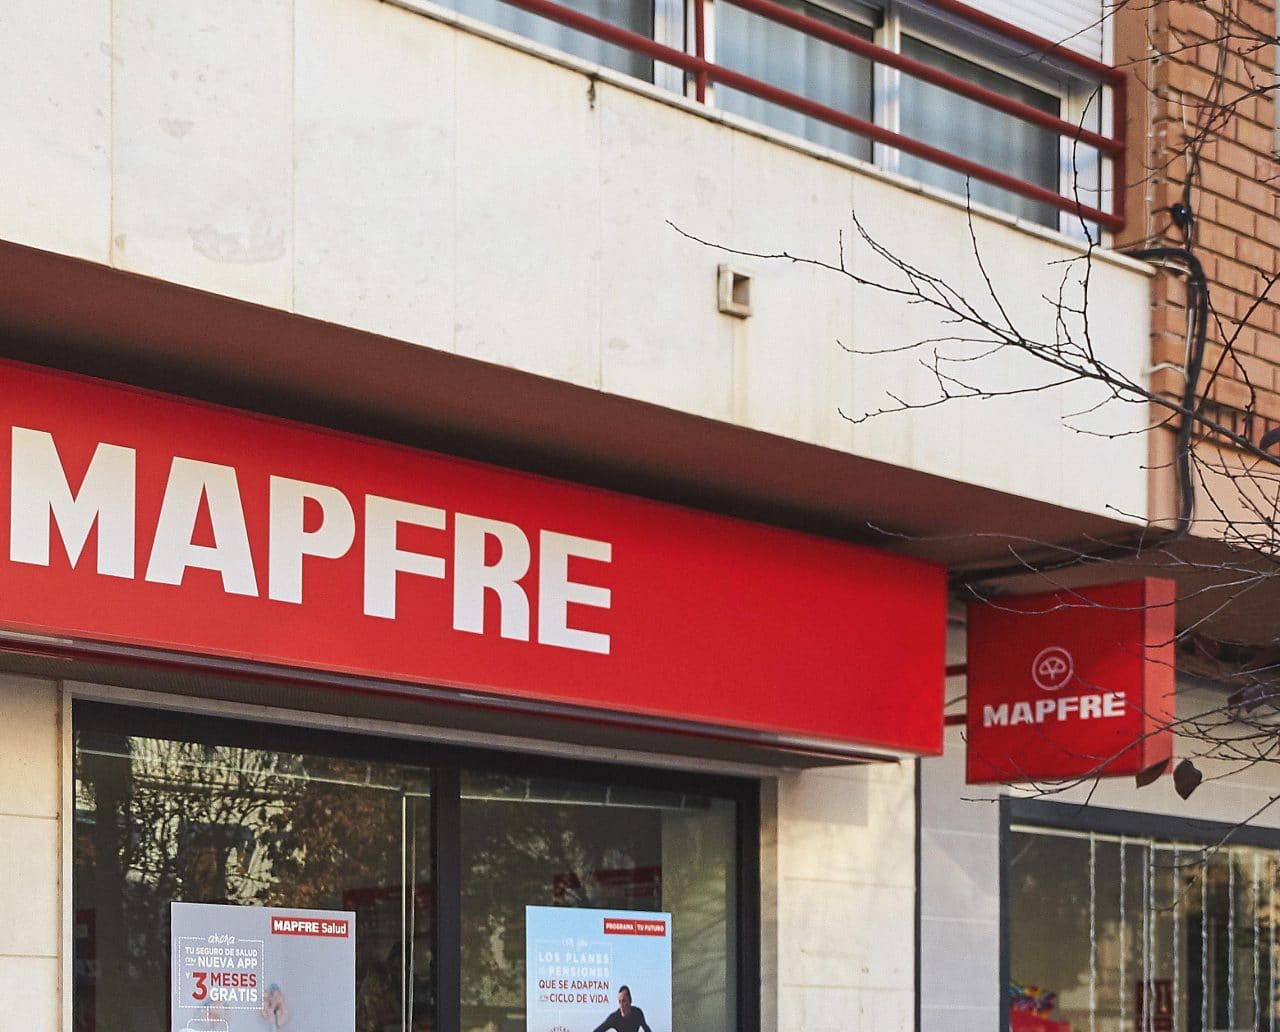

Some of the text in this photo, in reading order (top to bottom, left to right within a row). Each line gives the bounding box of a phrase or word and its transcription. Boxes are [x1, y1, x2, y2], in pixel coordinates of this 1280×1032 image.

[9, 425, 612, 655] MAPFRE
[983, 691, 1126, 727] MAPFRE
[273, 919, 347, 934] MAPFRE Salud
[185, 946, 258, 957] TU SEGURO DE SALUD
[198, 956, 235, 968] NUEVA
[237, 957, 258, 969] APP
[192, 971, 208, 1001] 3
[210, 972, 257, 987] MESES
[539, 979, 609, 990] QUE SE ADAPTAN
[210, 987, 258, 1002] GRATIS
[549, 993, 575, 1003] CICLO
[576, 994, 587, 1003] DE
[589, 994, 609, 1003] VIDA
